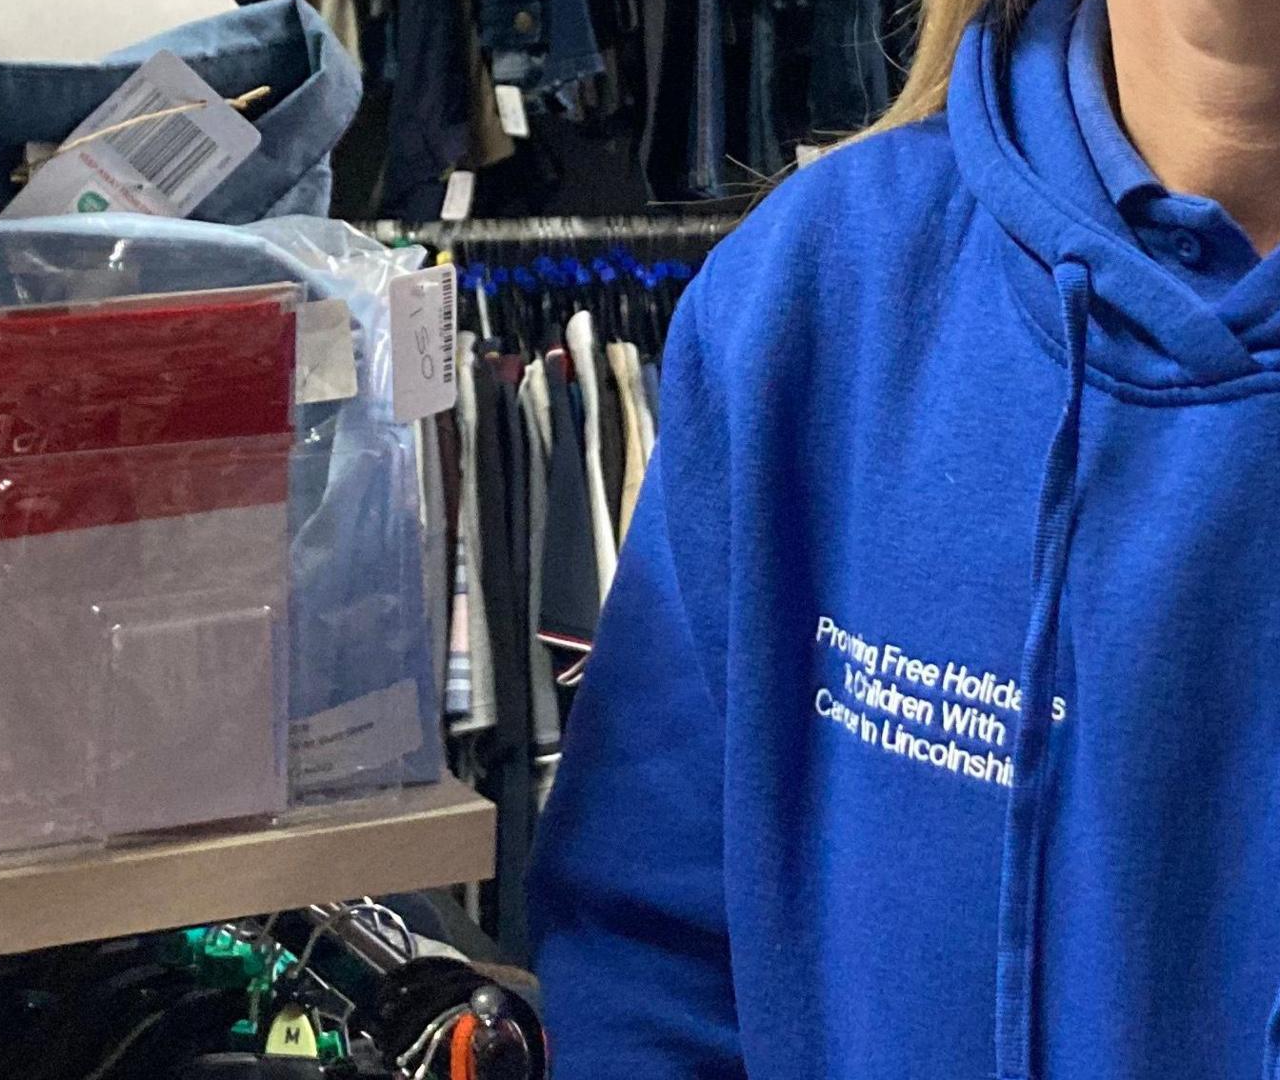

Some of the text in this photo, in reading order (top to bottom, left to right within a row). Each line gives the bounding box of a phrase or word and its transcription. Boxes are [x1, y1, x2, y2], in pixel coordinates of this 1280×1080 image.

[881, 644, 940, 687] Free
[942, 661, 1066, 721] Holidas
[942, 700, 1007, 747] With
[882, 719, 1015, 788] Lincolnshi
[285, 1026, 300, 1045] M
